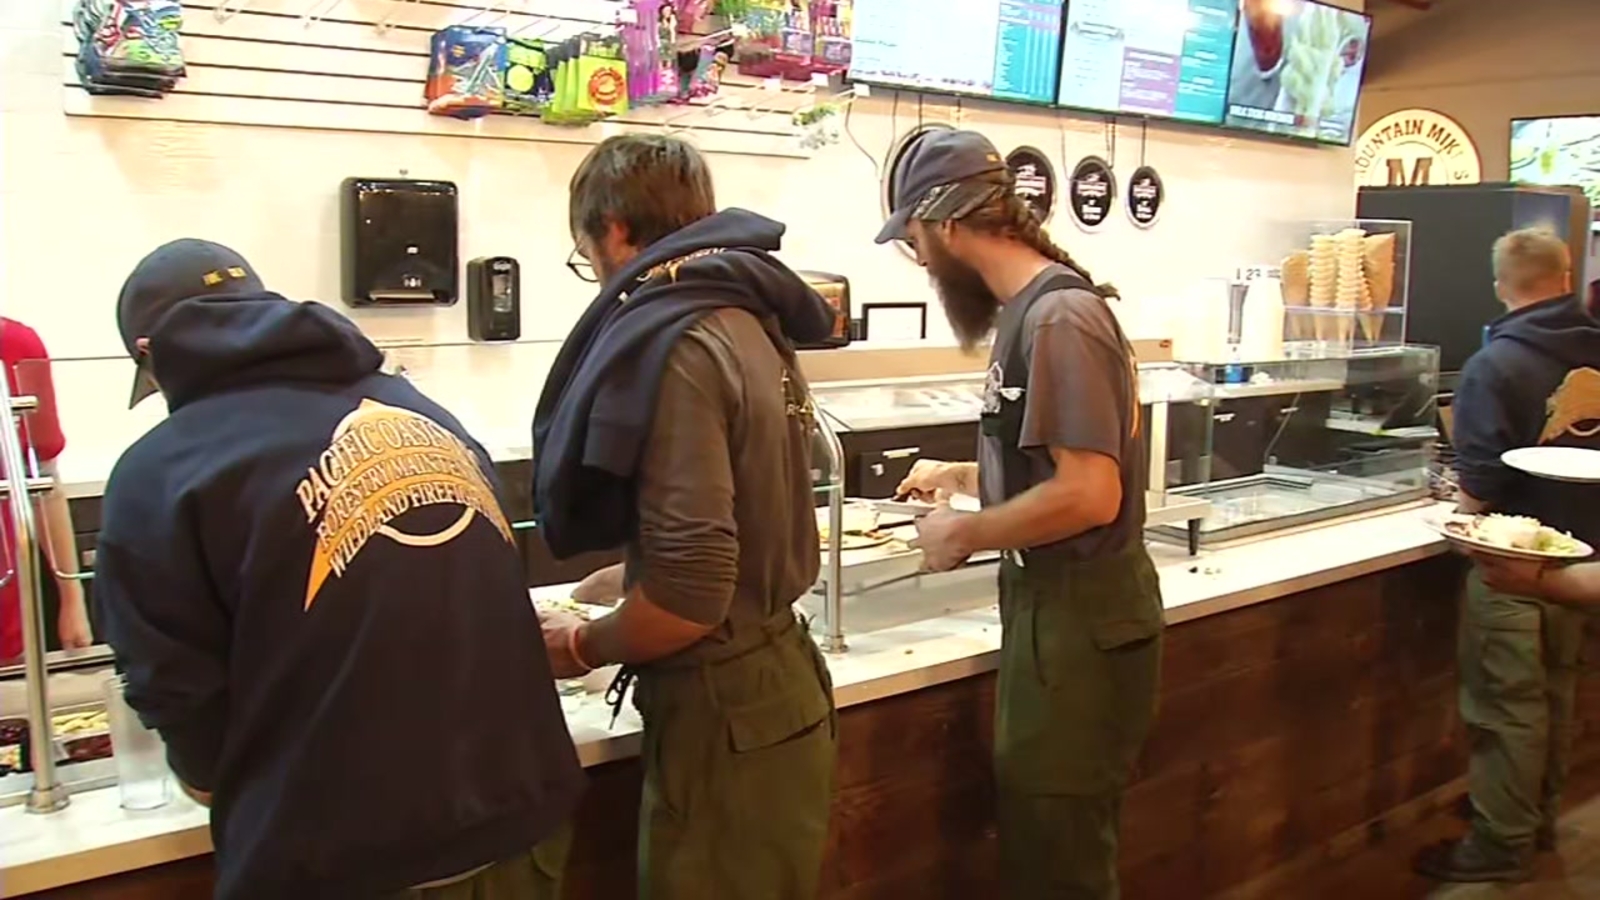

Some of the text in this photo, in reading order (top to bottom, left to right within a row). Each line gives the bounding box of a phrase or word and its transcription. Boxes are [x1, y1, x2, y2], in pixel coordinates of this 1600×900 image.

[296, 422, 383, 524] PACIFIC
[316, 464, 392, 554] FORESTRY
[329, 490, 411, 579] WILDLAND
